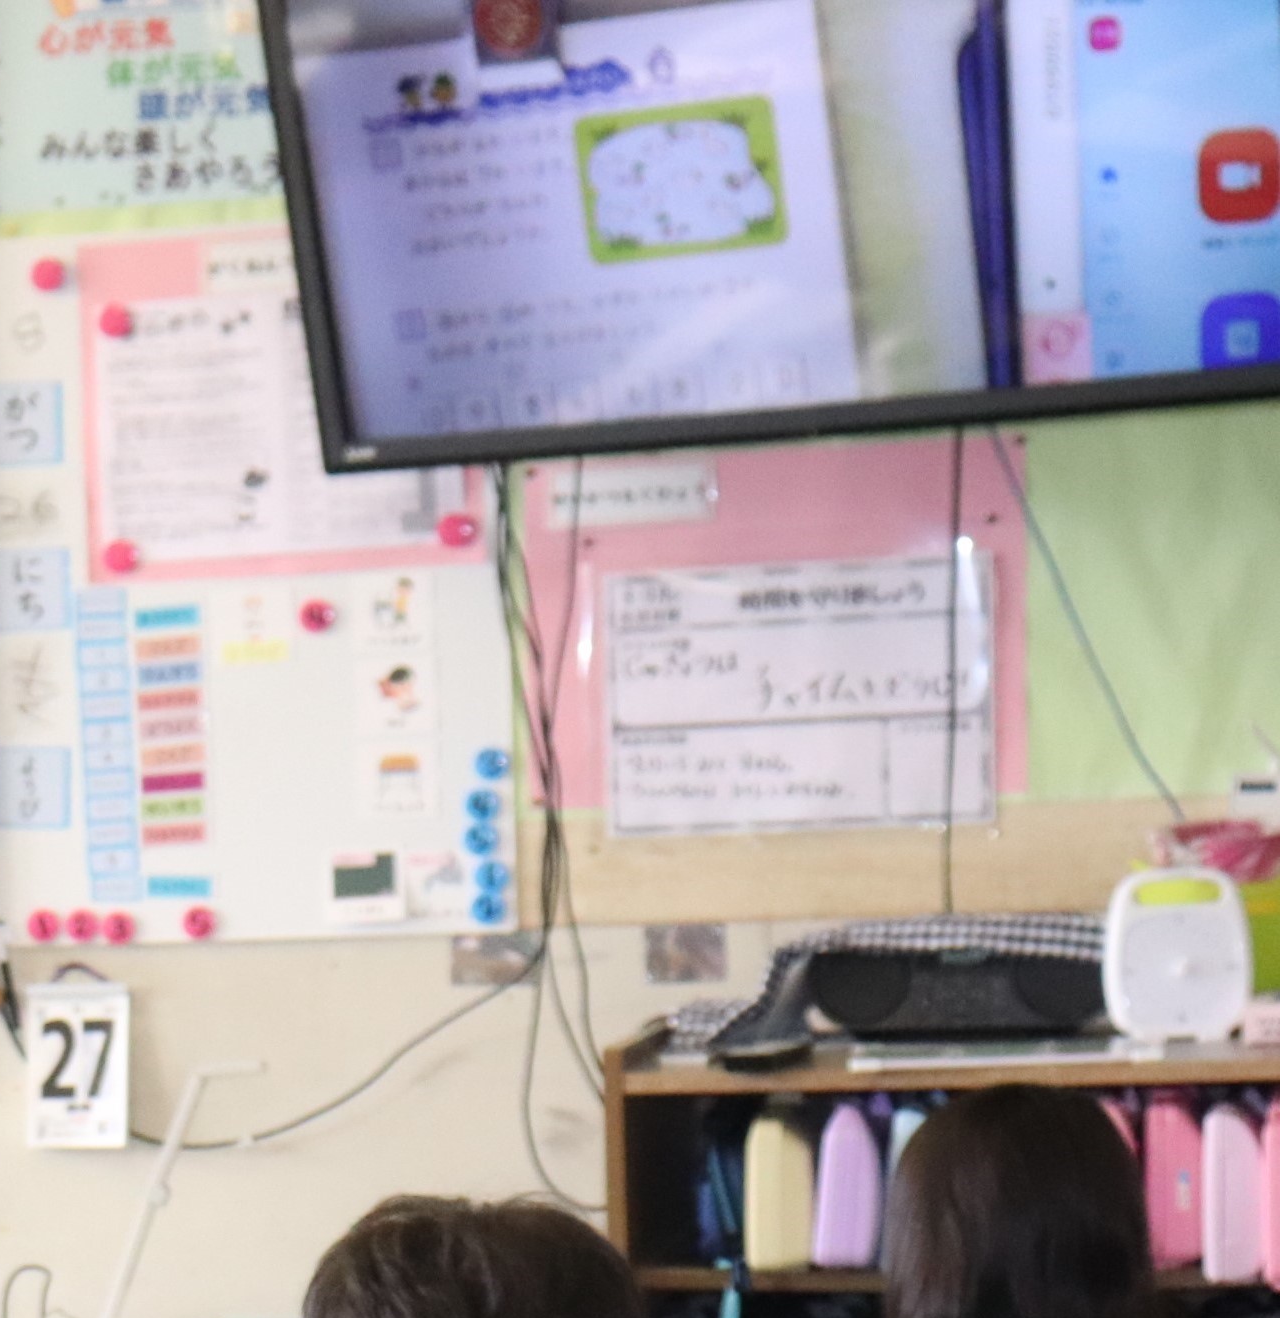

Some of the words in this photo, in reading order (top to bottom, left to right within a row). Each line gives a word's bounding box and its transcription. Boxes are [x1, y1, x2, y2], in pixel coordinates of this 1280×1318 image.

[39, 16, 175, 58] 心が元気
[40, 118, 217, 160] みんな楽しく
[3, 389, 43, 454] がつ
[13, 556, 45, 622] にち
[41, 1017, 116, 1099] 27
